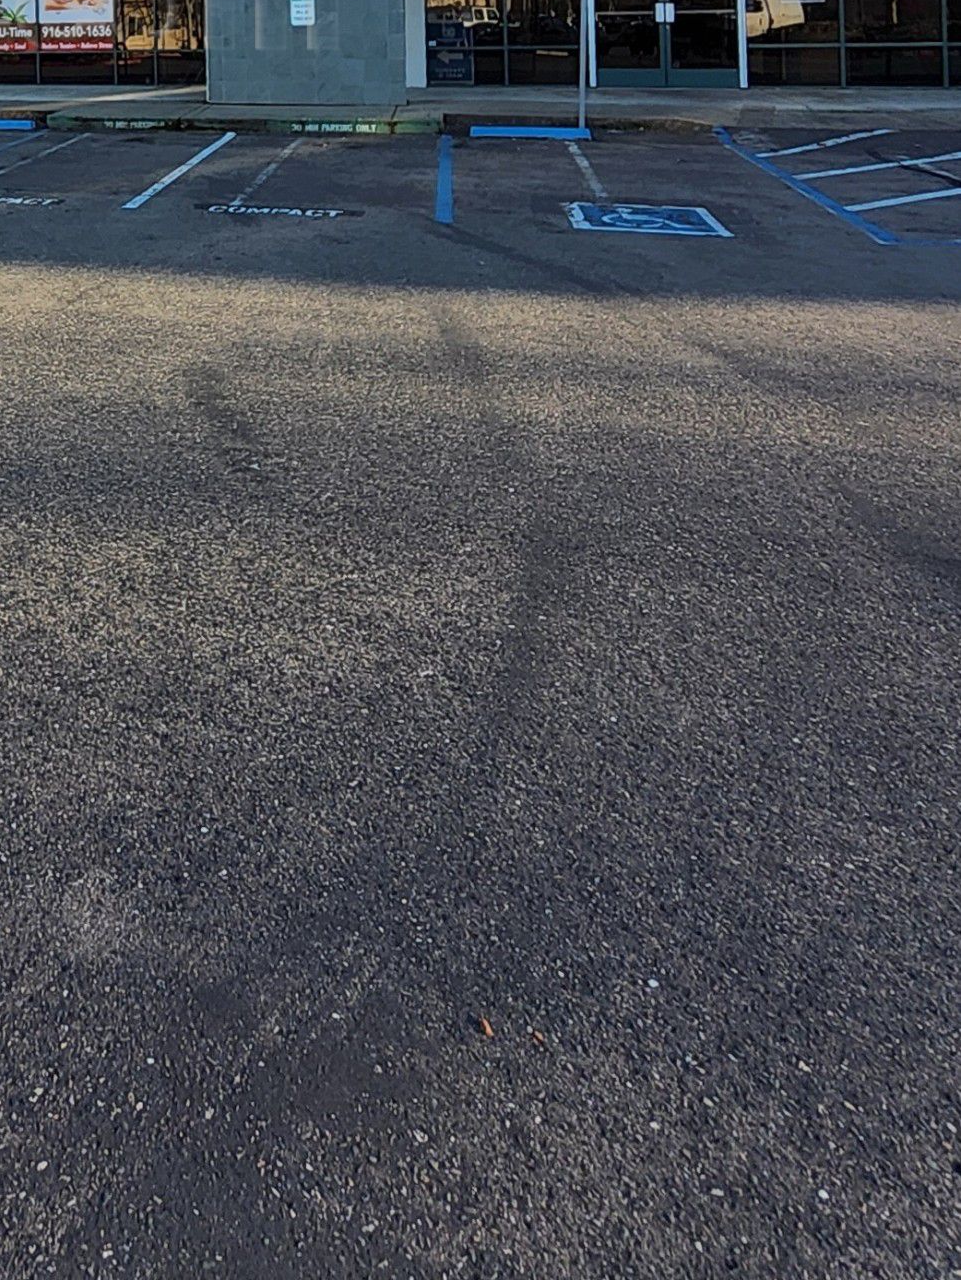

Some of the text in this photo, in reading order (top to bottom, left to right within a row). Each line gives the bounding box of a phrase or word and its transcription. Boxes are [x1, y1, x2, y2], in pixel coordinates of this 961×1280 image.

[0, 27, 33, 38] U-Time
[42, 25, 113, 38] 916-510-1636
[321, 123, 353, 132] PARKING
[355, 123, 376, 133] ONLY
[208, 204, 344, 218] COMPACT
